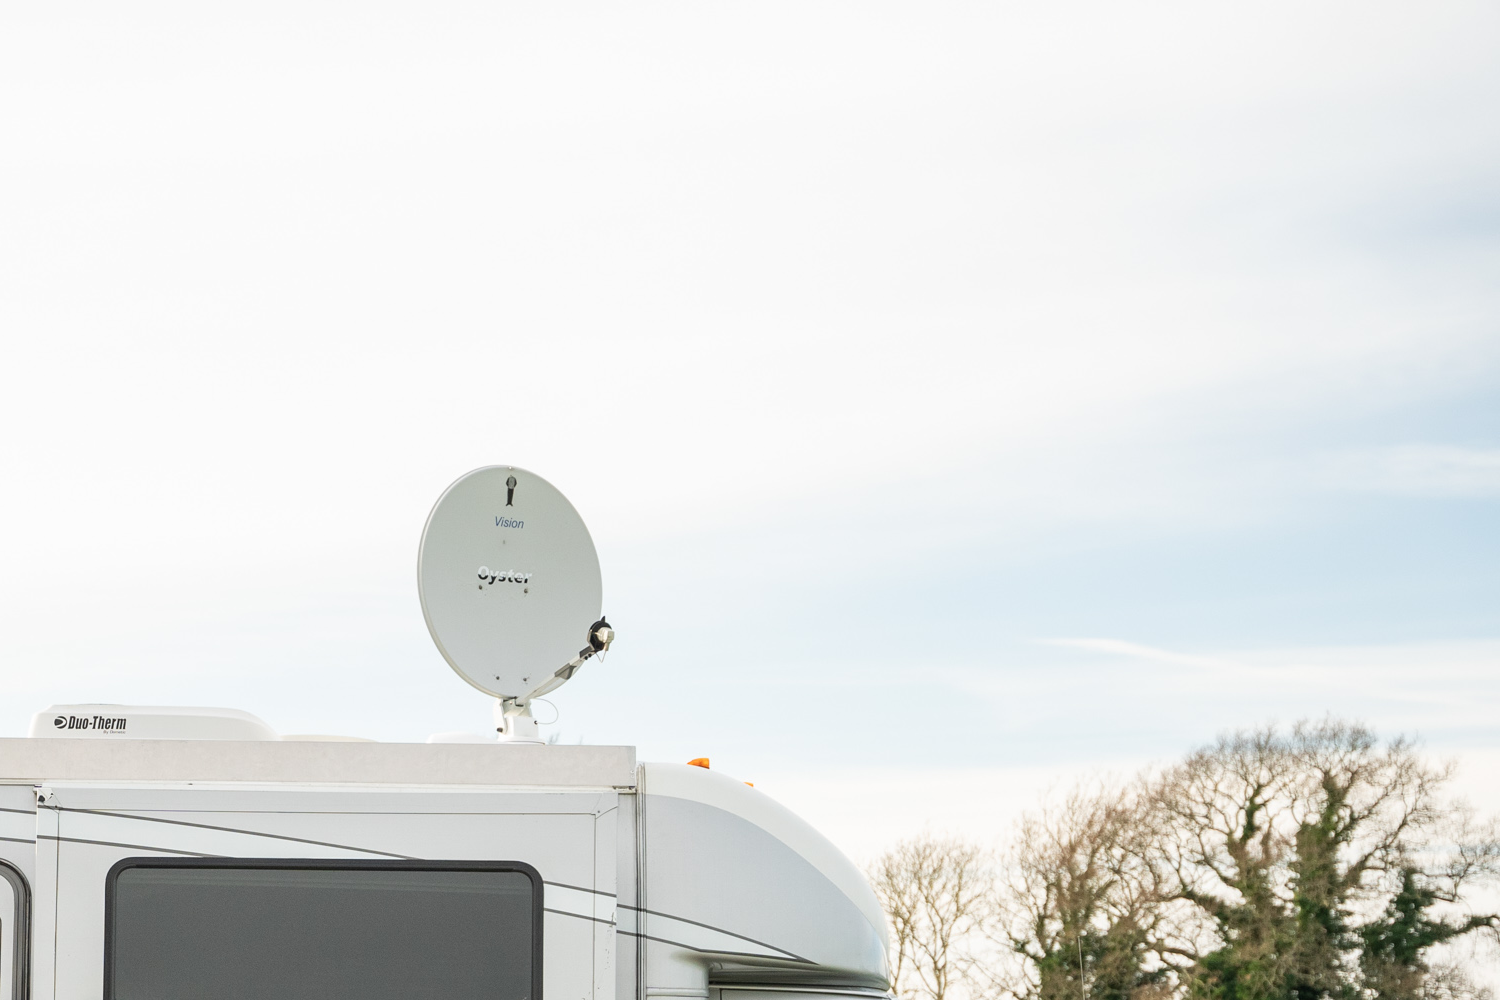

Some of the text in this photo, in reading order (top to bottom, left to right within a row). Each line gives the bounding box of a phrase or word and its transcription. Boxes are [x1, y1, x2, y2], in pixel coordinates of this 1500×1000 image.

[495, 516, 524, 529] Vision
[478, 566, 532, 585] Oyster
[68, 716, 127, 730] Duo-Therm
